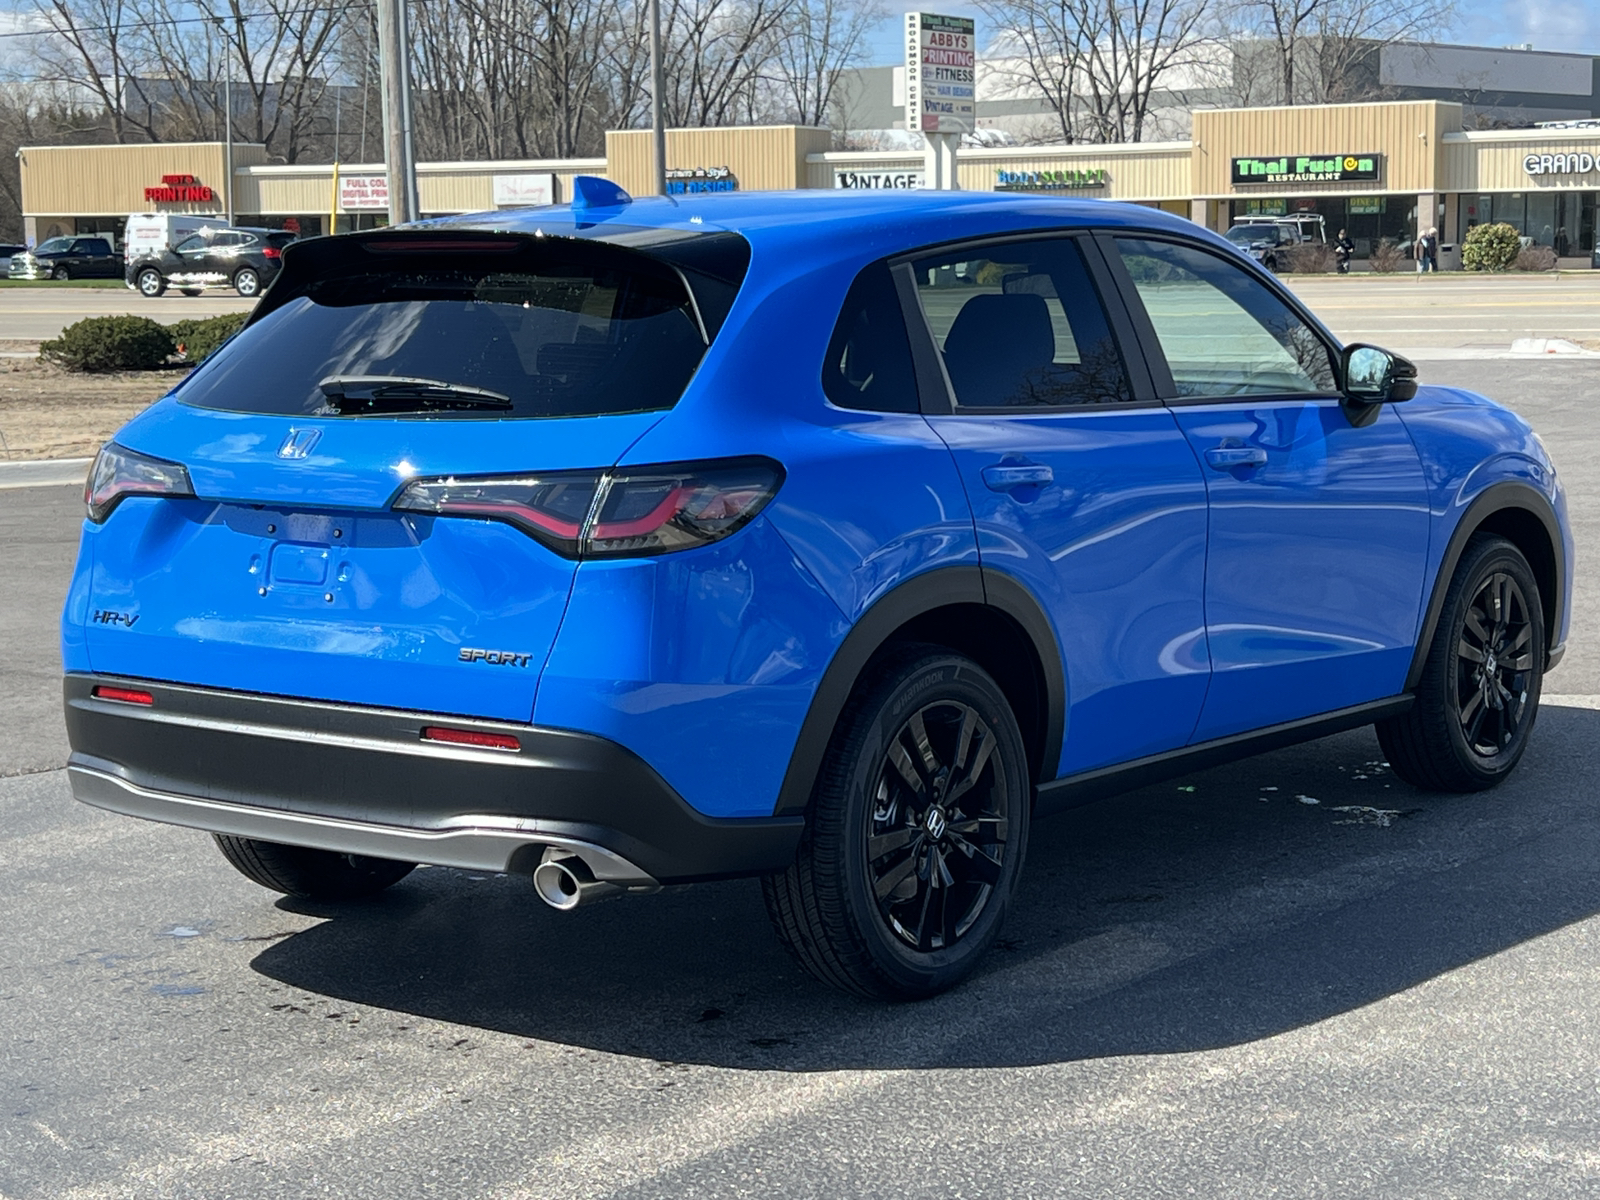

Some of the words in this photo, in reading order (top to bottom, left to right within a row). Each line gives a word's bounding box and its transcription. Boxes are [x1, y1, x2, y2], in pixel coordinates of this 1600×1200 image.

[908, 15, 917, 81] BROADMOOR
[930, 33, 967, 48] ABBYS
[922, 49, 973, 66] PRINTING
[935, 67, 974, 82] FITNESS
[909, 86, 917, 129] CENTER
[924, 99, 954, 114] VINTAGE
[1236, 158, 1288, 176] Thai
[1296, 156, 1374, 174] Fusion
[346, 179, 367, 187] FULL
[369, 179, 388, 187] COL
[837, 173, 917, 189] VINTAGE
[1267, 173, 1341, 182] RESTAURANT
[145, 186, 212, 202] PRINTING
[342, 190, 369, 198] DIGITAL
[92, 609, 140, 627] HR-V
[459, 647, 533, 667] SPORT
